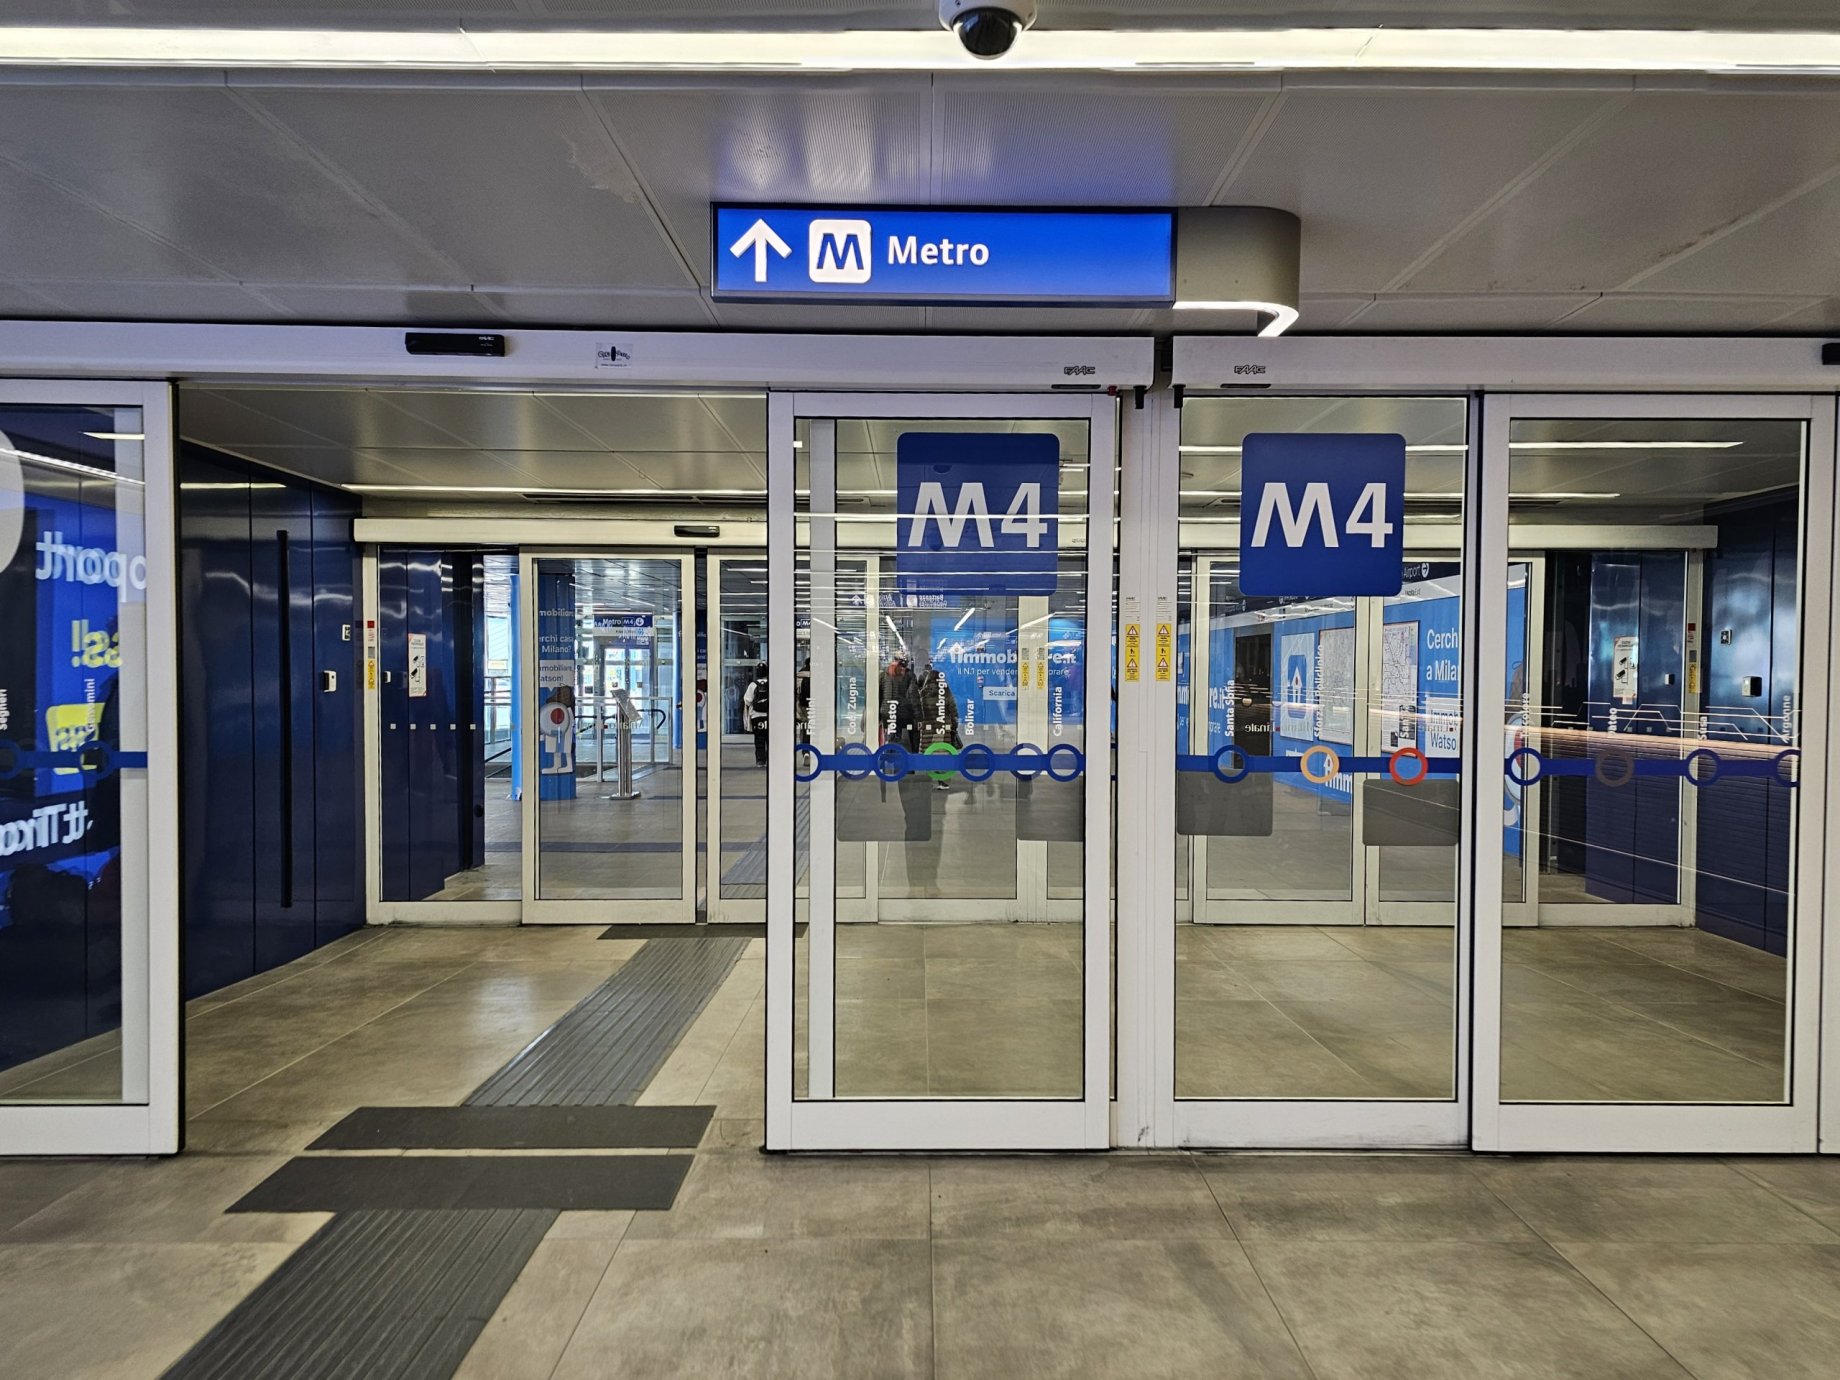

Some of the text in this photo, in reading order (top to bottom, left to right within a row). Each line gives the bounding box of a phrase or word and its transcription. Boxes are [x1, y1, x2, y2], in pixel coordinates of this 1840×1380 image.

[816, 233, 989, 271] M Metro
[1063, 365, 1096, 376] FAAC
[1233, 364, 1267, 375] FAAC
[907, 481, 1048, 548] M4
[1250, 481, 1394, 548] M4
[1427, 628, 1458, 650] Cerch
[991, 668, 1018, 676] vender
[1426, 665, 1433, 681] a
[847, 676, 859, 710] Zugna
[936, 671, 948, 726] Ambrogio
[988, 689, 1016, 697] Scarica
[887, 700, 899, 735] Tolstoj
[965, 698, 975, 736] Bolivar
[1052, 686, 1063, 737] California
[1224, 707, 1235, 737] Santa
[1521, 692, 1529, 738] Tcolore
[1698, 716, 1708, 740] Susa
[1781, 695, 1792, 741] Argonne
